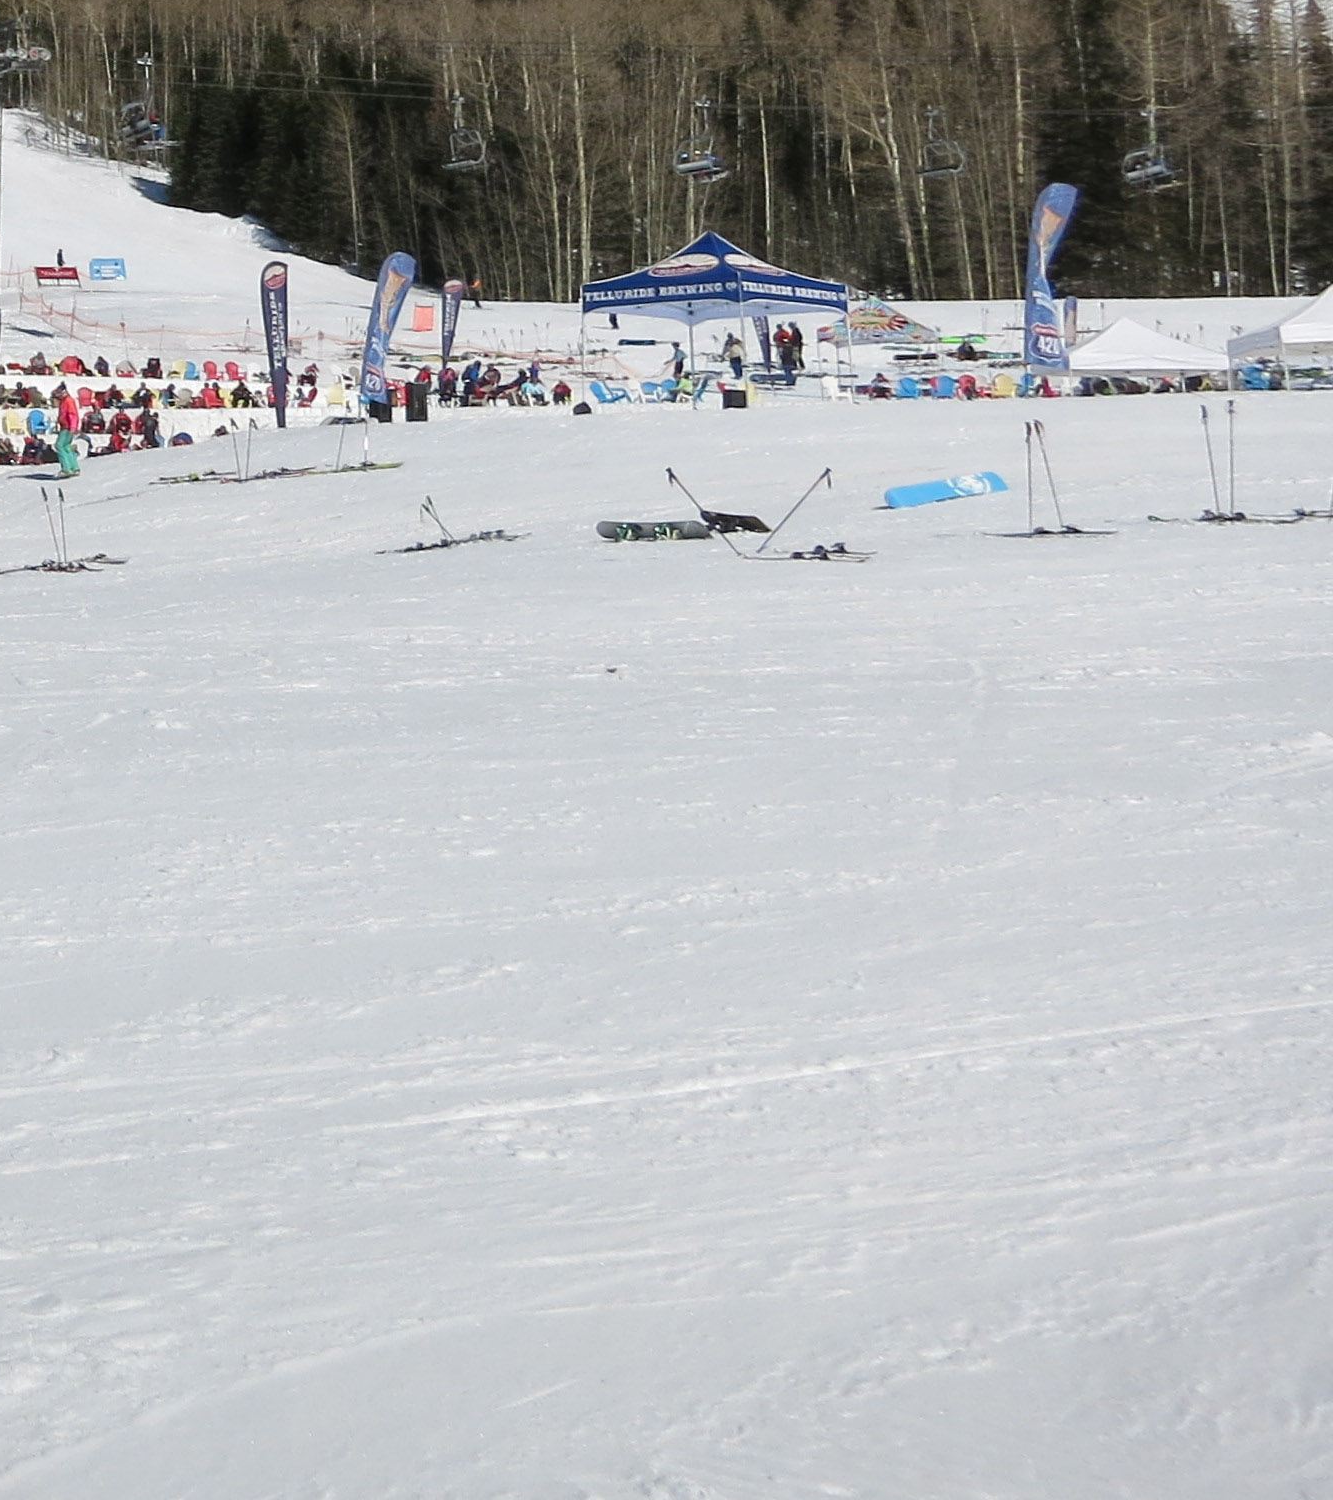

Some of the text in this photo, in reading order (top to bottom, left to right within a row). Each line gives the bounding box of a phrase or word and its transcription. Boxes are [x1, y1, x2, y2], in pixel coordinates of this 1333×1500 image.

[584, 288, 655, 301] TELLURIDE
[659, 282, 723, 296] BREWING
[268, 291, 282, 369] TELLURIDE
